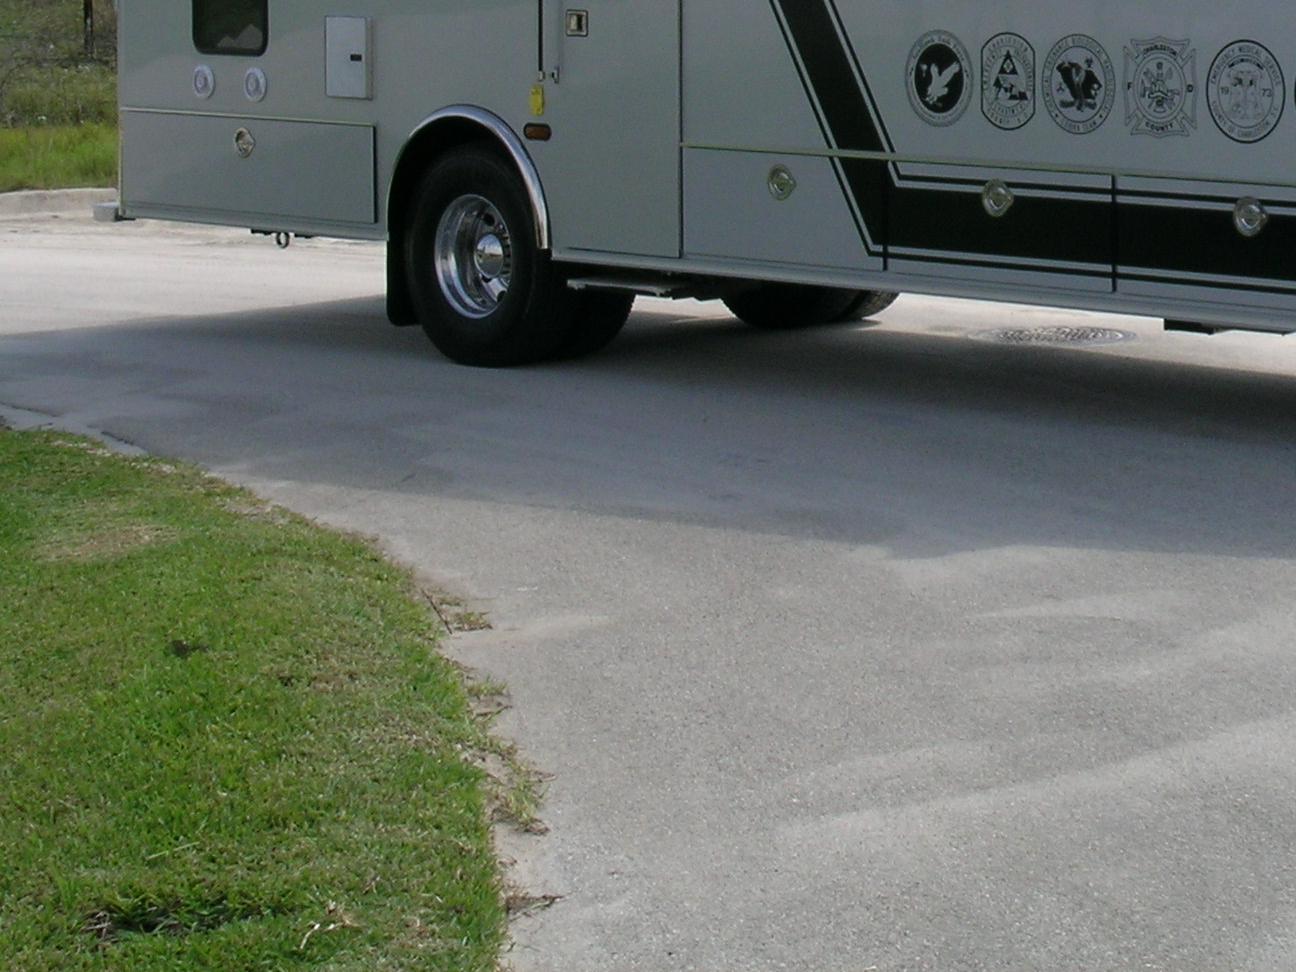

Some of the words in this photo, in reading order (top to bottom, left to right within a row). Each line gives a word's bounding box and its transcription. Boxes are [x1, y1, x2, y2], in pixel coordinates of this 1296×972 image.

[1127, 81, 1133, 91] F
[1186, 84, 1194, 93] D
[1261, 87, 1273, 98] 73
[1145, 121, 1174, 132] COUNTY
